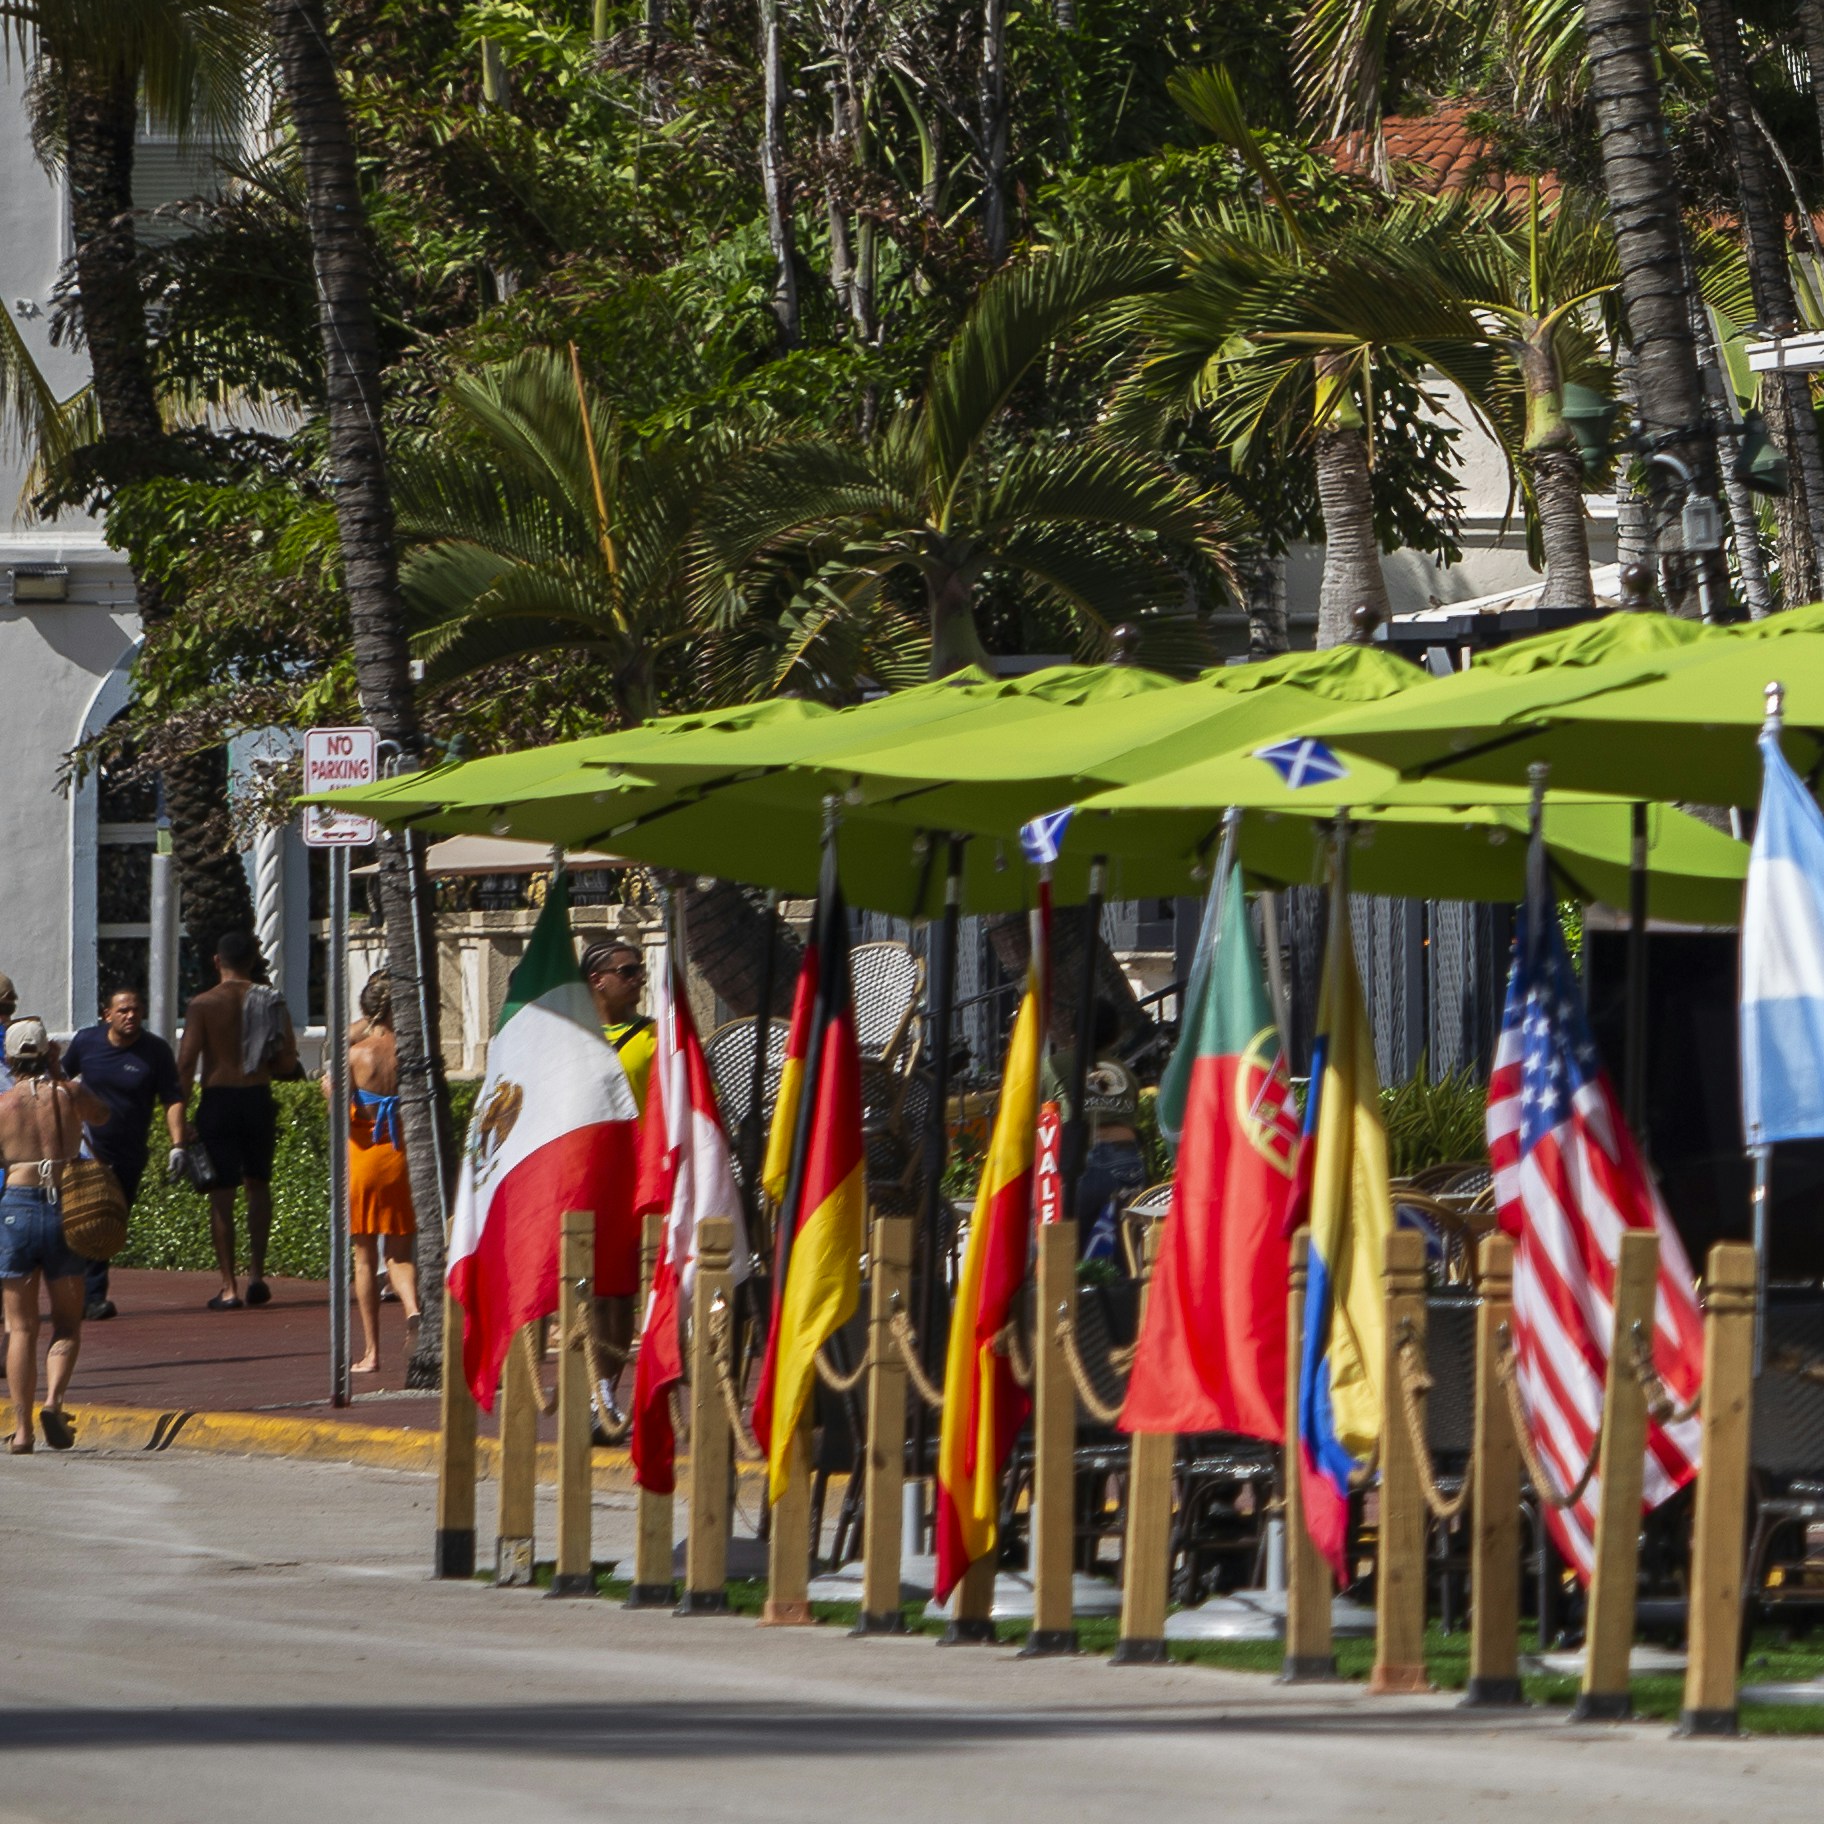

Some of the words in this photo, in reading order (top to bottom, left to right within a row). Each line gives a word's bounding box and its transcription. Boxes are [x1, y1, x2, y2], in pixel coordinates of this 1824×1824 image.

[327, 736, 353, 755] NO
[311, 759, 369, 779] PARKING
[1037, 1124, 1058, 1225] VALE
